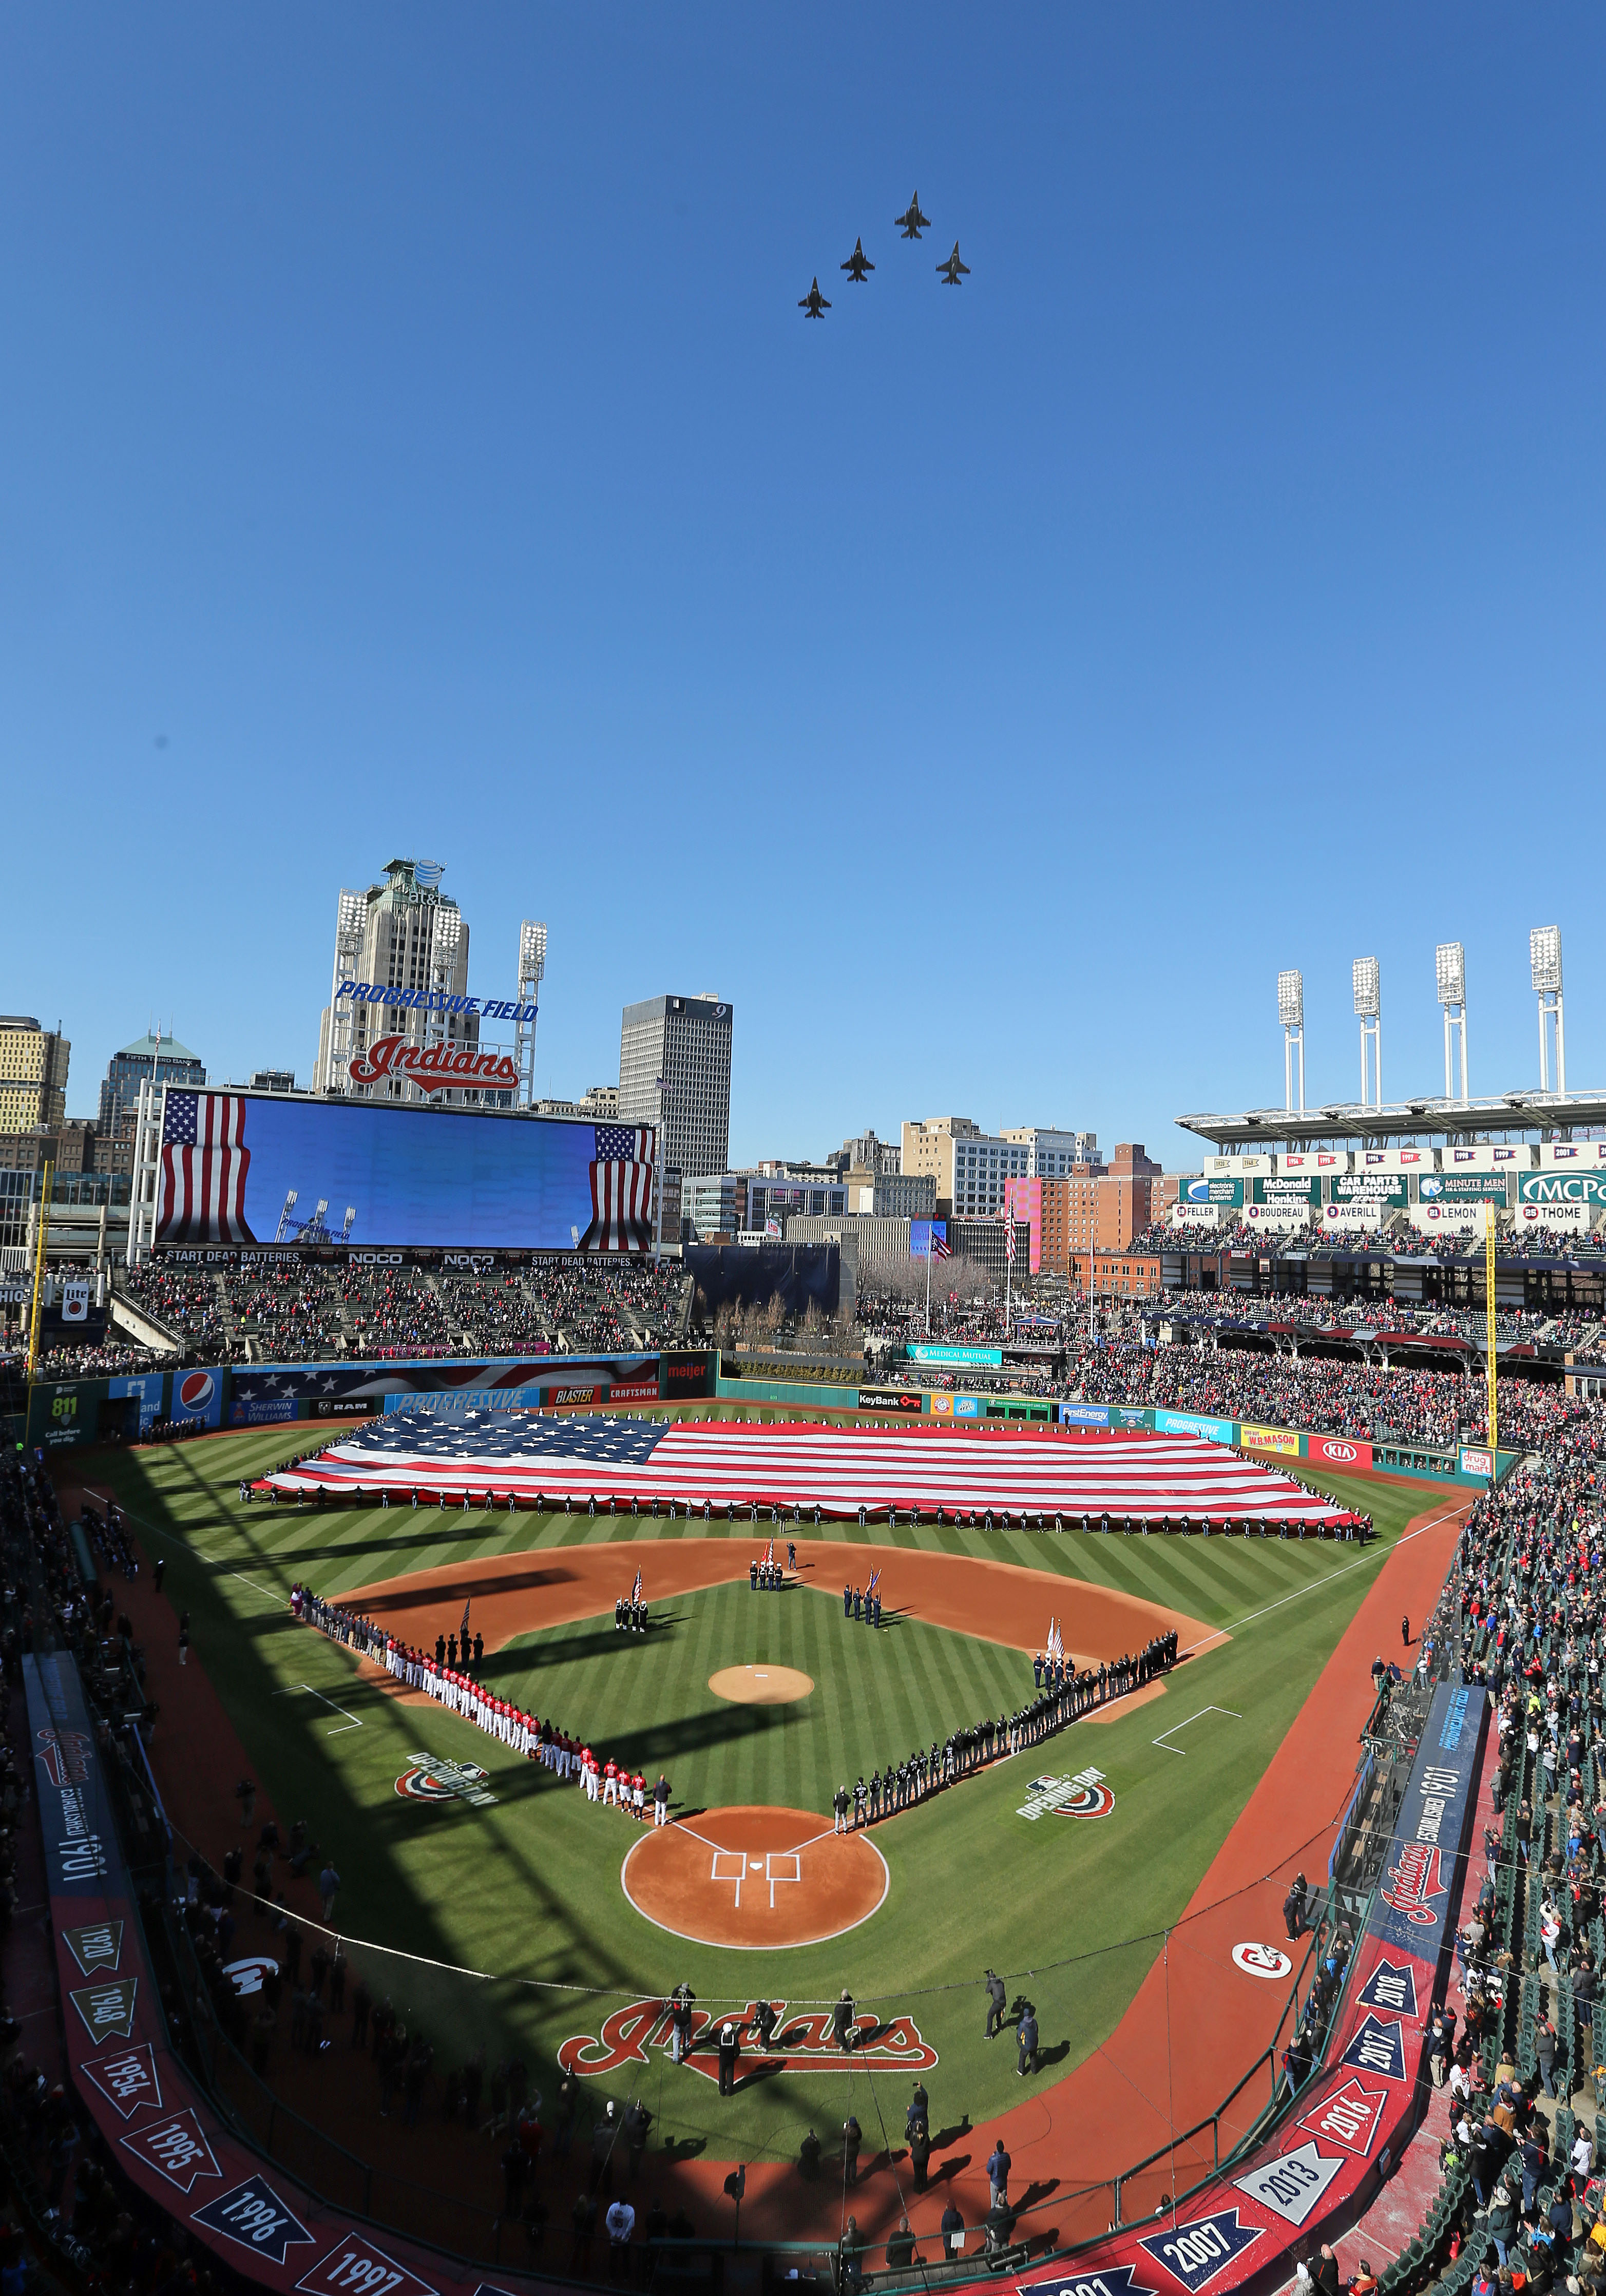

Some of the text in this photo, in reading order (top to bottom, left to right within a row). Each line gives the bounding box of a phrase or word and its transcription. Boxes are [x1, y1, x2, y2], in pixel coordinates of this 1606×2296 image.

[409, 889, 444, 906] at&t
[335, 980, 540, 1023] PROGRESSIVE FIELD
[715, 1004, 726, 1019] 9
[348, 1035, 518, 1089] Indians
[1495, 1151, 1509, 1159] 1999
[1555, 1149, 1571, 1157] 2001
[1263, 1177, 1311, 1189] McDonald
[1340, 1176, 1399, 1185] CAR PARTS
[1445, 1178, 1505, 1187] MINUTE MEN
[1336, 1184, 1402, 1195] WAREHOUSE
[1187, 1208, 1214, 1216] FELLER
[1260, 1207, 1303, 1217] BOUDREAU
[1340, 1207, 1377, 1217] AVERILL
[1429, 1208, 1476, 1218] 21 LEMON
[1525, 1207, 1581, 1218] 25 THOME
[167, 1250, 203, 1261] START
[241, 1251, 302, 1263] BATTERIES.
[349, 1253, 403, 1264] NOCO
[444, 1254, 494, 1266] NOCO
[532, 1256, 559, 1266] START
[562, 1257, 584, 1266] DEAD
[66, 1289, 87, 1301] Lite
[929, 1349, 991, 1360] MEDICAL MUTUAL
[668, 1363, 705, 1379] meijer
[399, 1389, 525, 1410] PROGRESSIVE
[555, 1389, 593, 1404] BLASTER
[611, 1387, 657, 1398] CRAFTSMAN
[52, 1397, 77, 1417] 811
[249, 1402, 292, 1412] SHERWIN
[859, 1395, 899, 1407] KeyBank
[1063, 1407, 1108, 1420] FirstEnergy
[1165, 1418, 1220, 1436] PROGRESSIVE
[1329, 1445, 1351, 1458] KIA
[1463, 1450, 1486, 1466] drug
[1465, 1463, 1491, 1474] mart
[406, 1752, 499, 1806] OPENING DAY
[1024, 1773, 1070, 1801] 20 19
[1419, 1765, 1461, 1798] 1901
[1016, 1766, 1107, 1821] OPENING DAY
[61, 1788, 89, 1836] ESTABLISHED
[1416, 1797, 1446, 1845] ESTABLISHED
[59, 1834, 107, 1882] 1901
[1381, 1843, 1445, 1926] Indians
[81, 1928, 114, 1959] 1920
[1374, 1974, 1407, 2007] 2018
[90, 1988, 126, 2024] 1948
[1358, 2029, 1395, 2070] 2017
[104, 2056, 151, 2097] 1954
[1320, 2096, 1372, 2140] 2016
[147, 2123, 204, 2170] 1995
[1259, 2160, 1320, 2206] 2013
[221, 2192, 288, 2241] 1996
[1163, 2222, 1231, 2274] 2007
[327, 2253, 404, 2296] 1997
